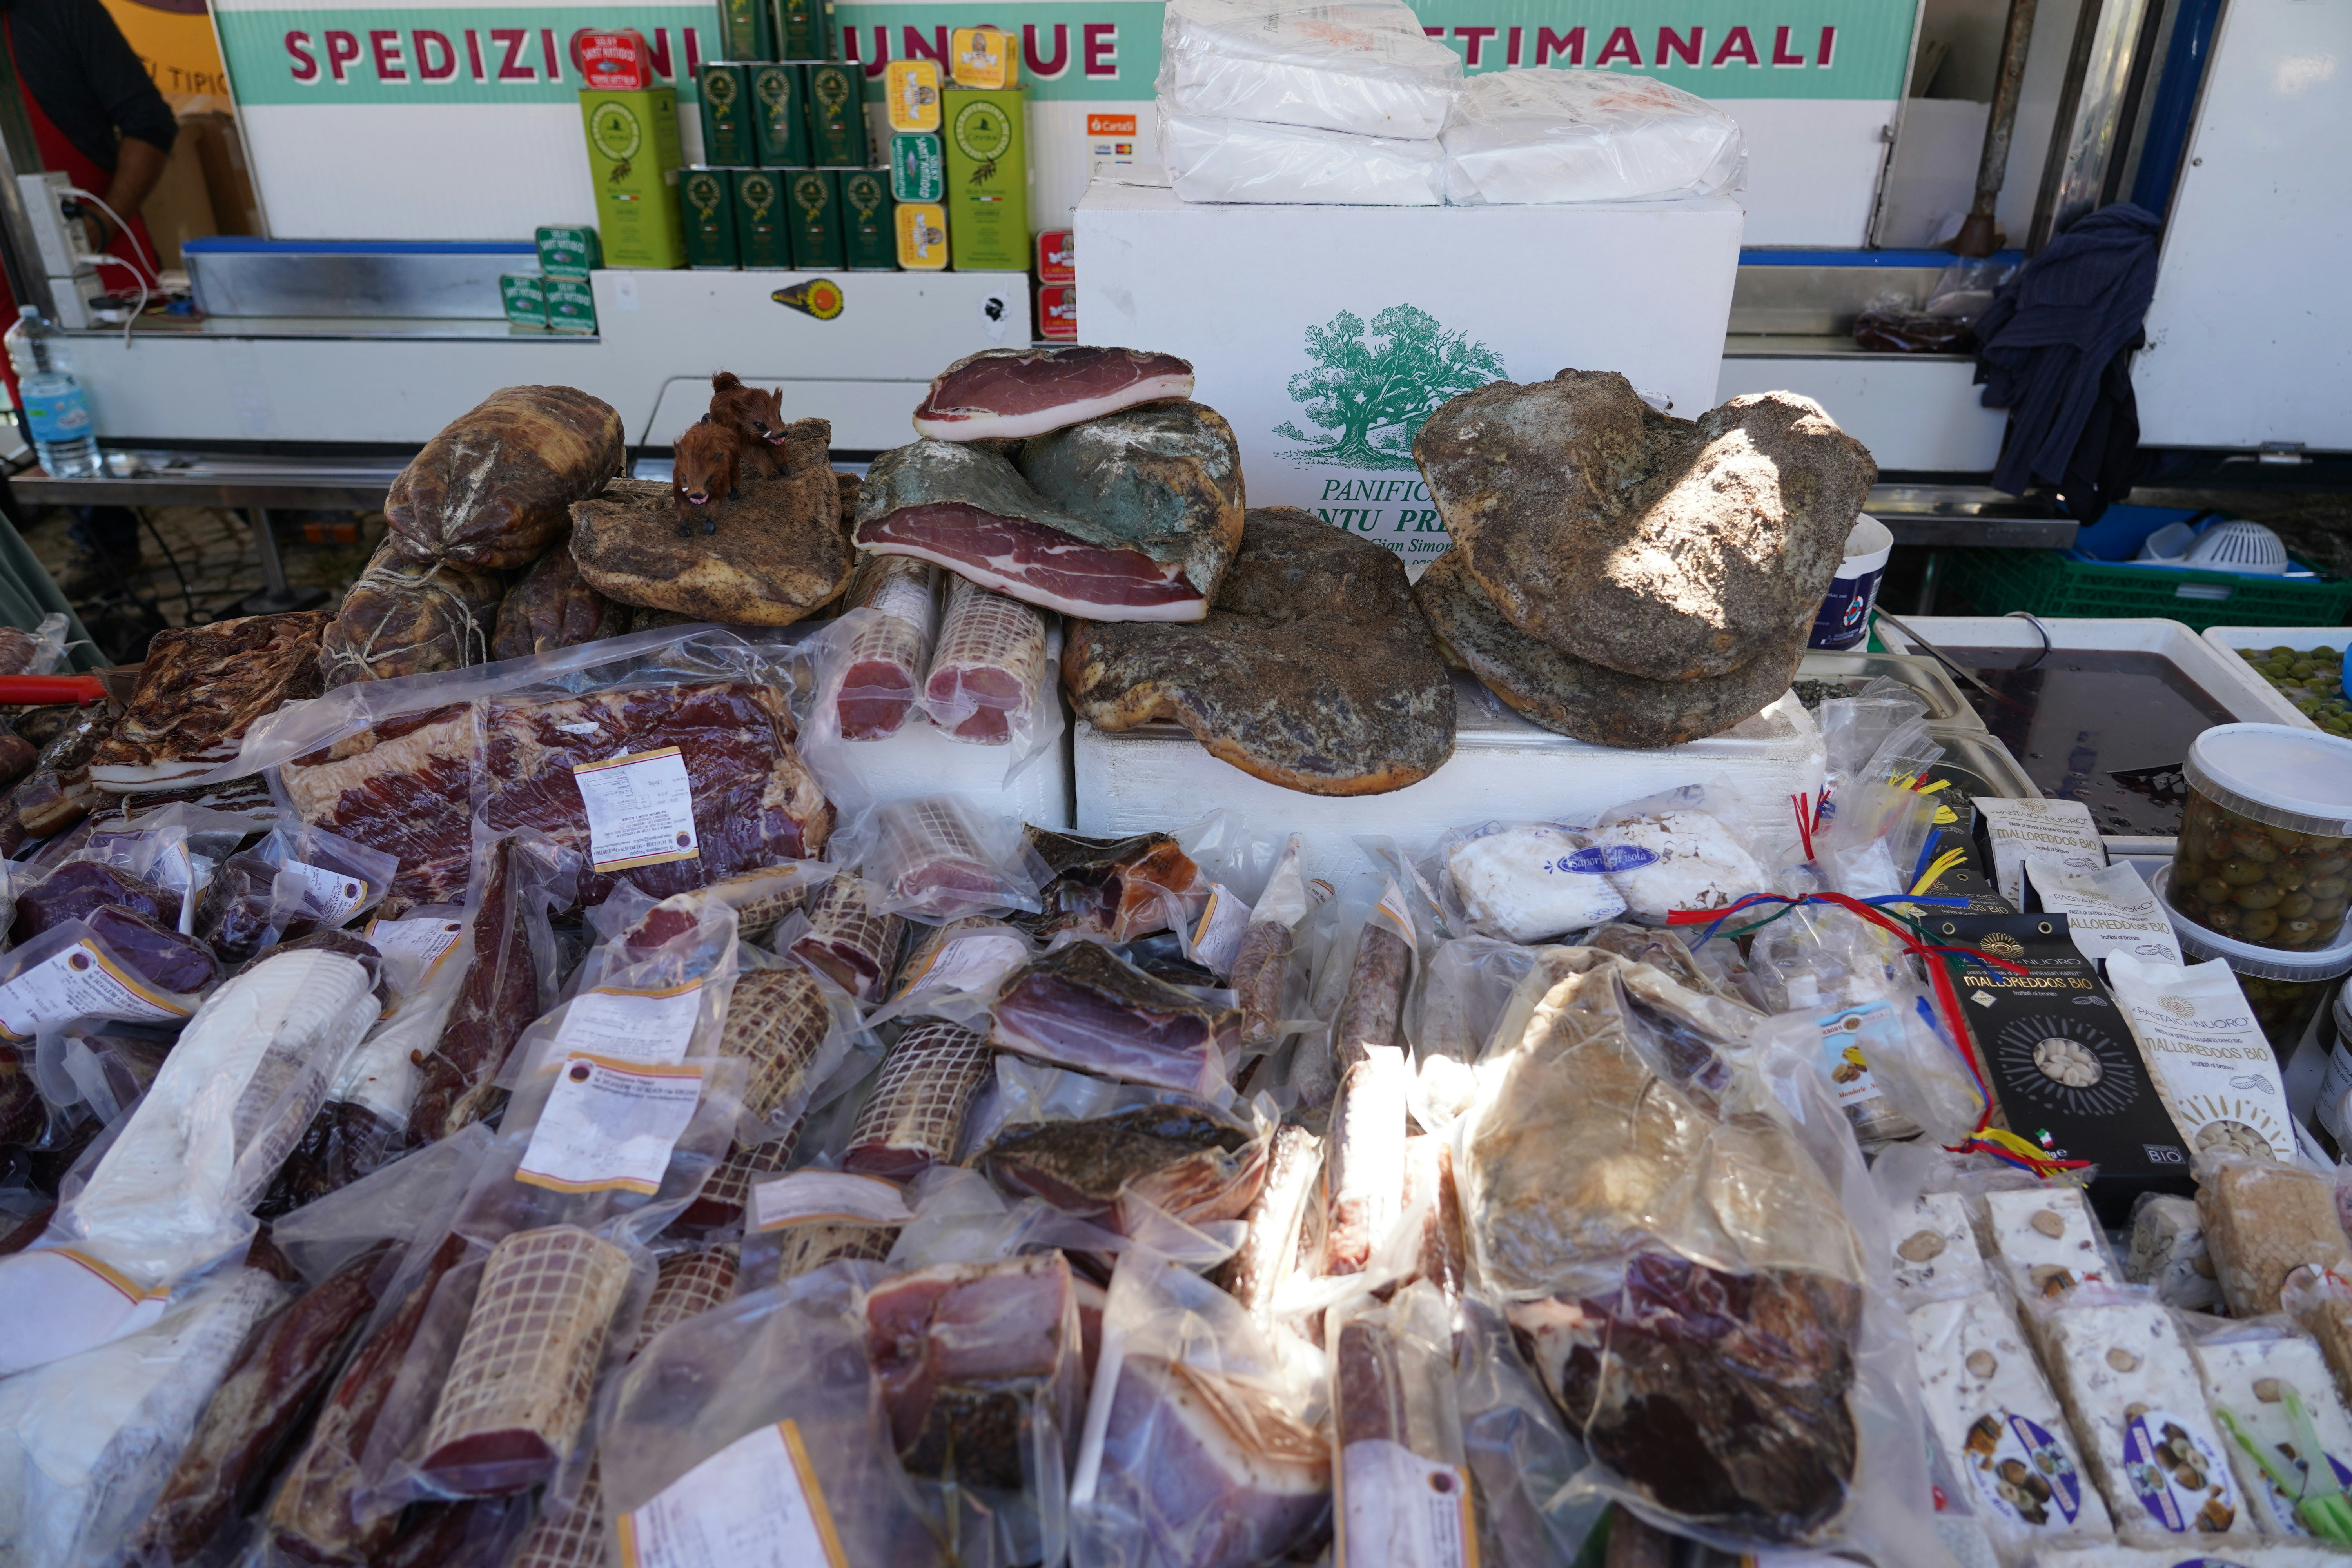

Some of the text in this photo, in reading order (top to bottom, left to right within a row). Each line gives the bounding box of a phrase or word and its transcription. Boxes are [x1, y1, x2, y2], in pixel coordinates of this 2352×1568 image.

[284, 28, 701, 85] SPEDIZINI
[843, 24, 1119, 82] UNUE
[1319, 479, 1435, 502] PANIFIC
[1307, 508, 1383, 532] NTU
[1995, 810, 2039, 818] PASTAIO
[646, 845, 668, 854] Giuseppina
[2079, 839, 2096, 850] BIO
[2054, 894, 2101, 905] PASTAIO
[1987, 906, 2009, 914] BIO
[2149, 922, 2170, 934] BIO
[97, 973, 127, 996] Giuseppina
[124, 992, 142, 1006] Nappo
[2067, 978, 2092, 989] BIO
[2137, 1007, 2187, 1026] PASTAIO
[2243, 1047, 2268, 1061] BIO
[1838, 1087, 1866, 1098] Mandorle
[2147, 1150, 2181, 1162] BIO
